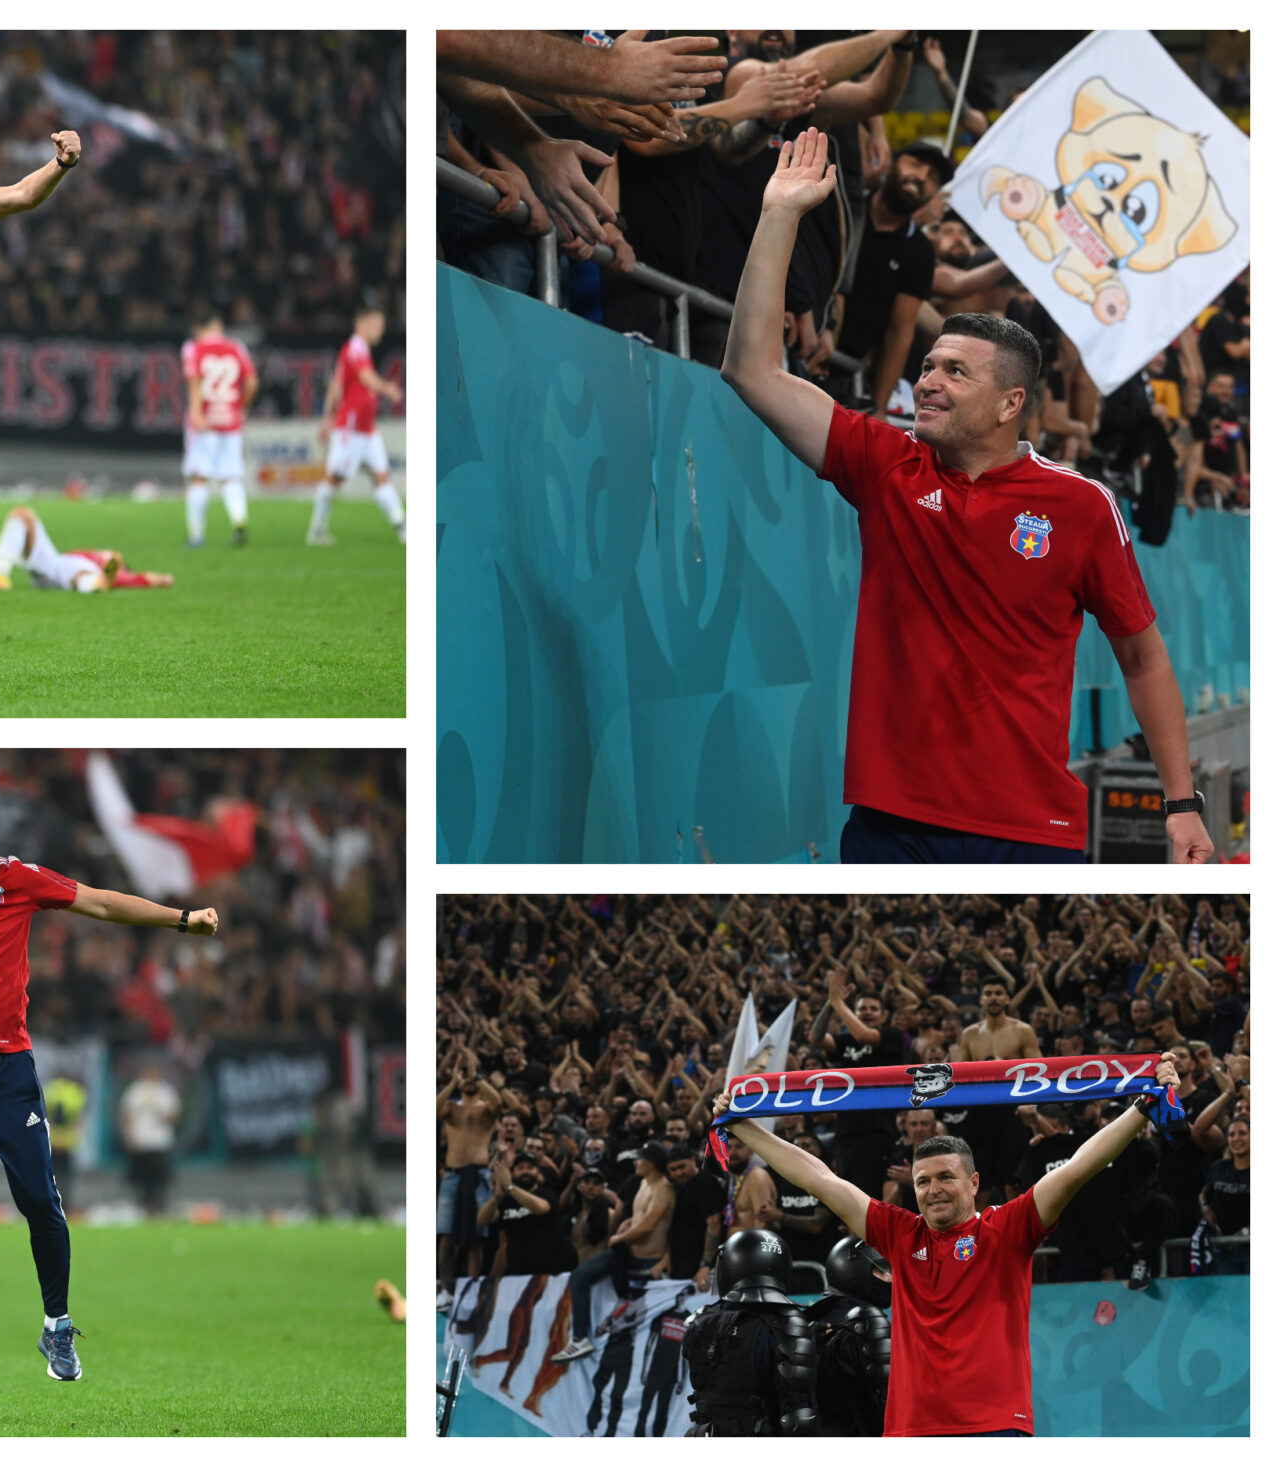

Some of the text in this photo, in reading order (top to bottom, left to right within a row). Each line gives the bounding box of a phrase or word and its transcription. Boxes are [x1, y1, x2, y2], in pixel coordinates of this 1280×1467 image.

[200, 354, 241, 404] 22
[917, 498, 942, 511] adidas
[1018, 516, 1049, 531] STEAUA
[728, 1059, 1153, 1113] OLD BOY
[760, 1244, 783, 1254] 2775
